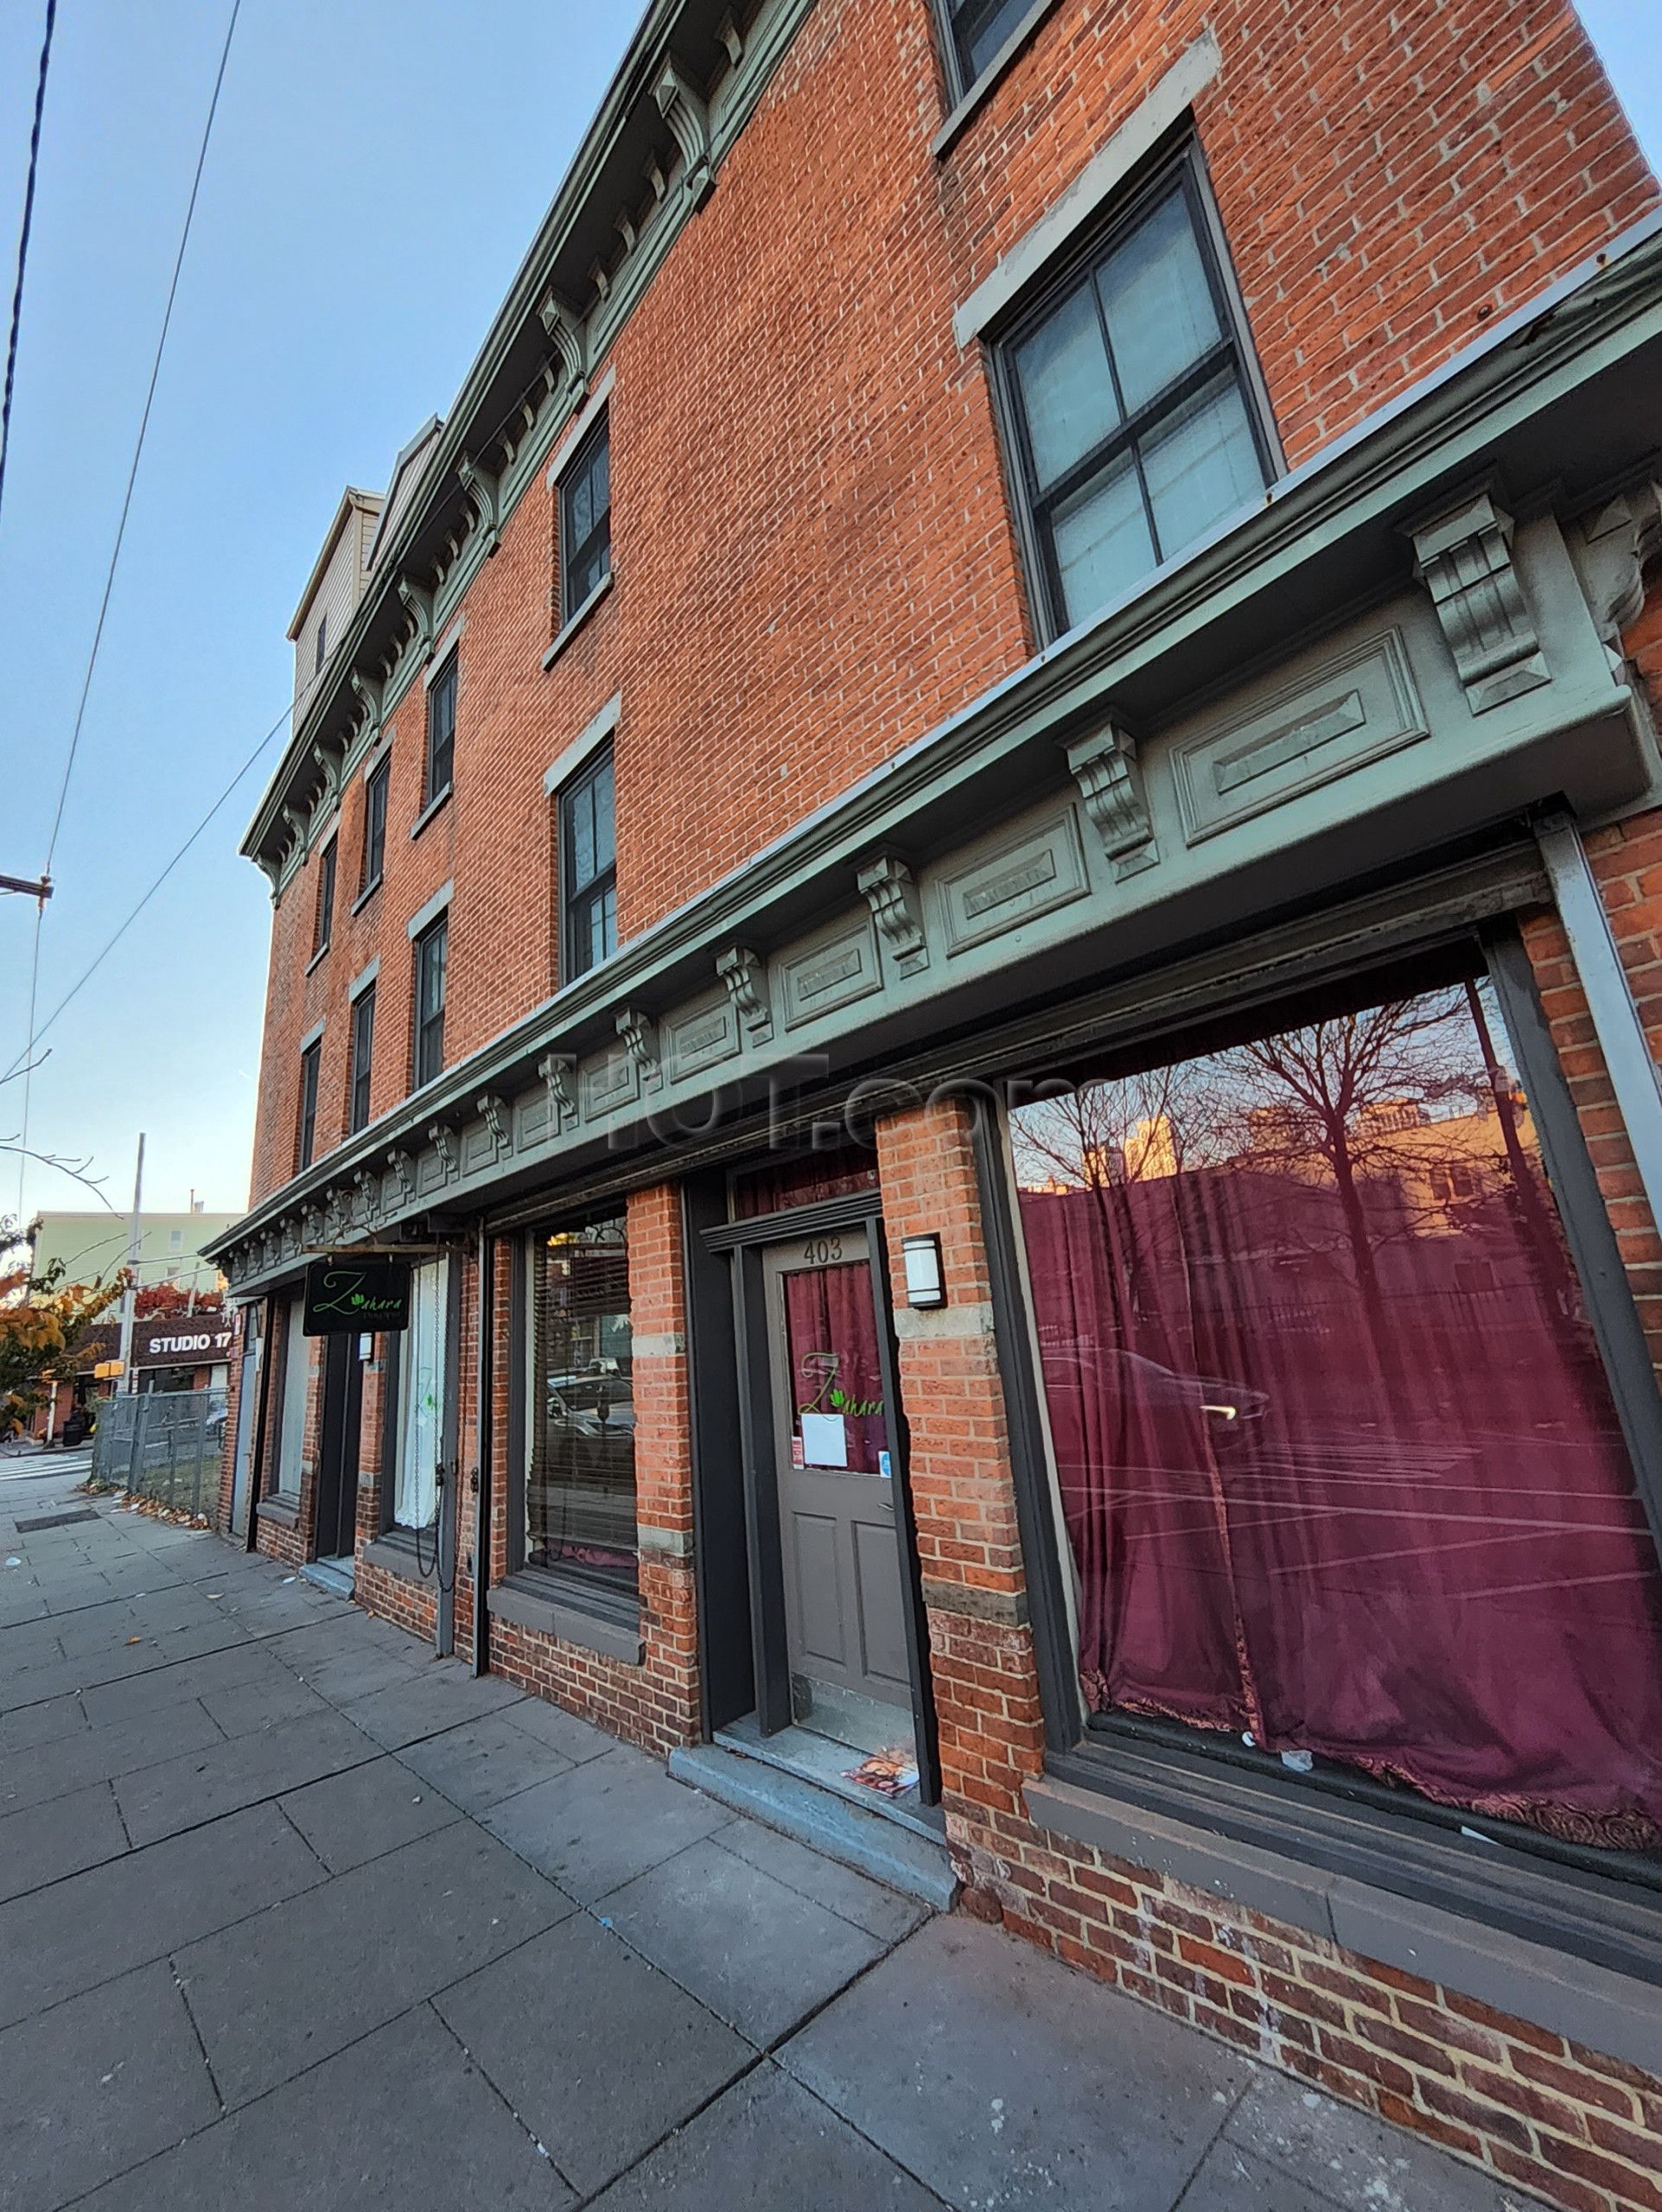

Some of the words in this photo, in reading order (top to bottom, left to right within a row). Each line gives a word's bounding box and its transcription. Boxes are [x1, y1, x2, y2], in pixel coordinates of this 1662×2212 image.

[804, 1236, 843, 1265] 403
[313, 1270, 402, 1314] Zahara
[149, 1333, 211, 1354] STUDIO
[213, 1332, 232, 1348] 17
